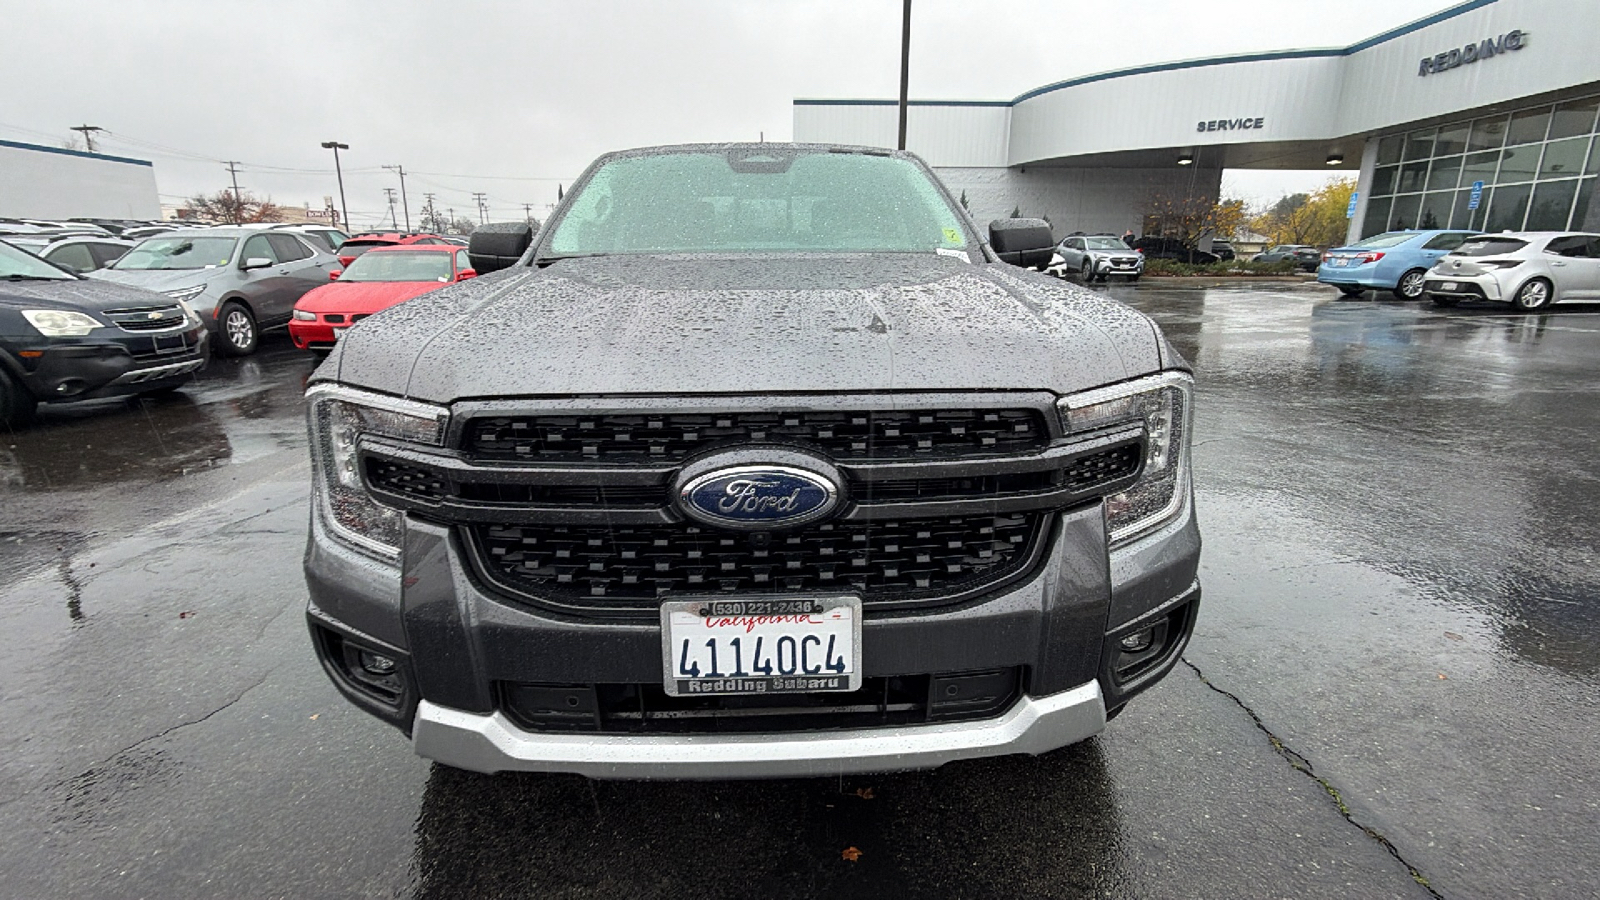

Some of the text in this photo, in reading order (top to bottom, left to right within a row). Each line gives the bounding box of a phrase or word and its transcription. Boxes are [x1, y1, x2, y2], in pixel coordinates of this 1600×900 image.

[1418, 29, 1528, 77] REDDING
[1196, 117, 1265, 133] SERVICE
[719, 479, 800, 513] Ford
[679, 634, 846, 678] 41140C4
[688, 677, 839, 692] Redding Subaru
